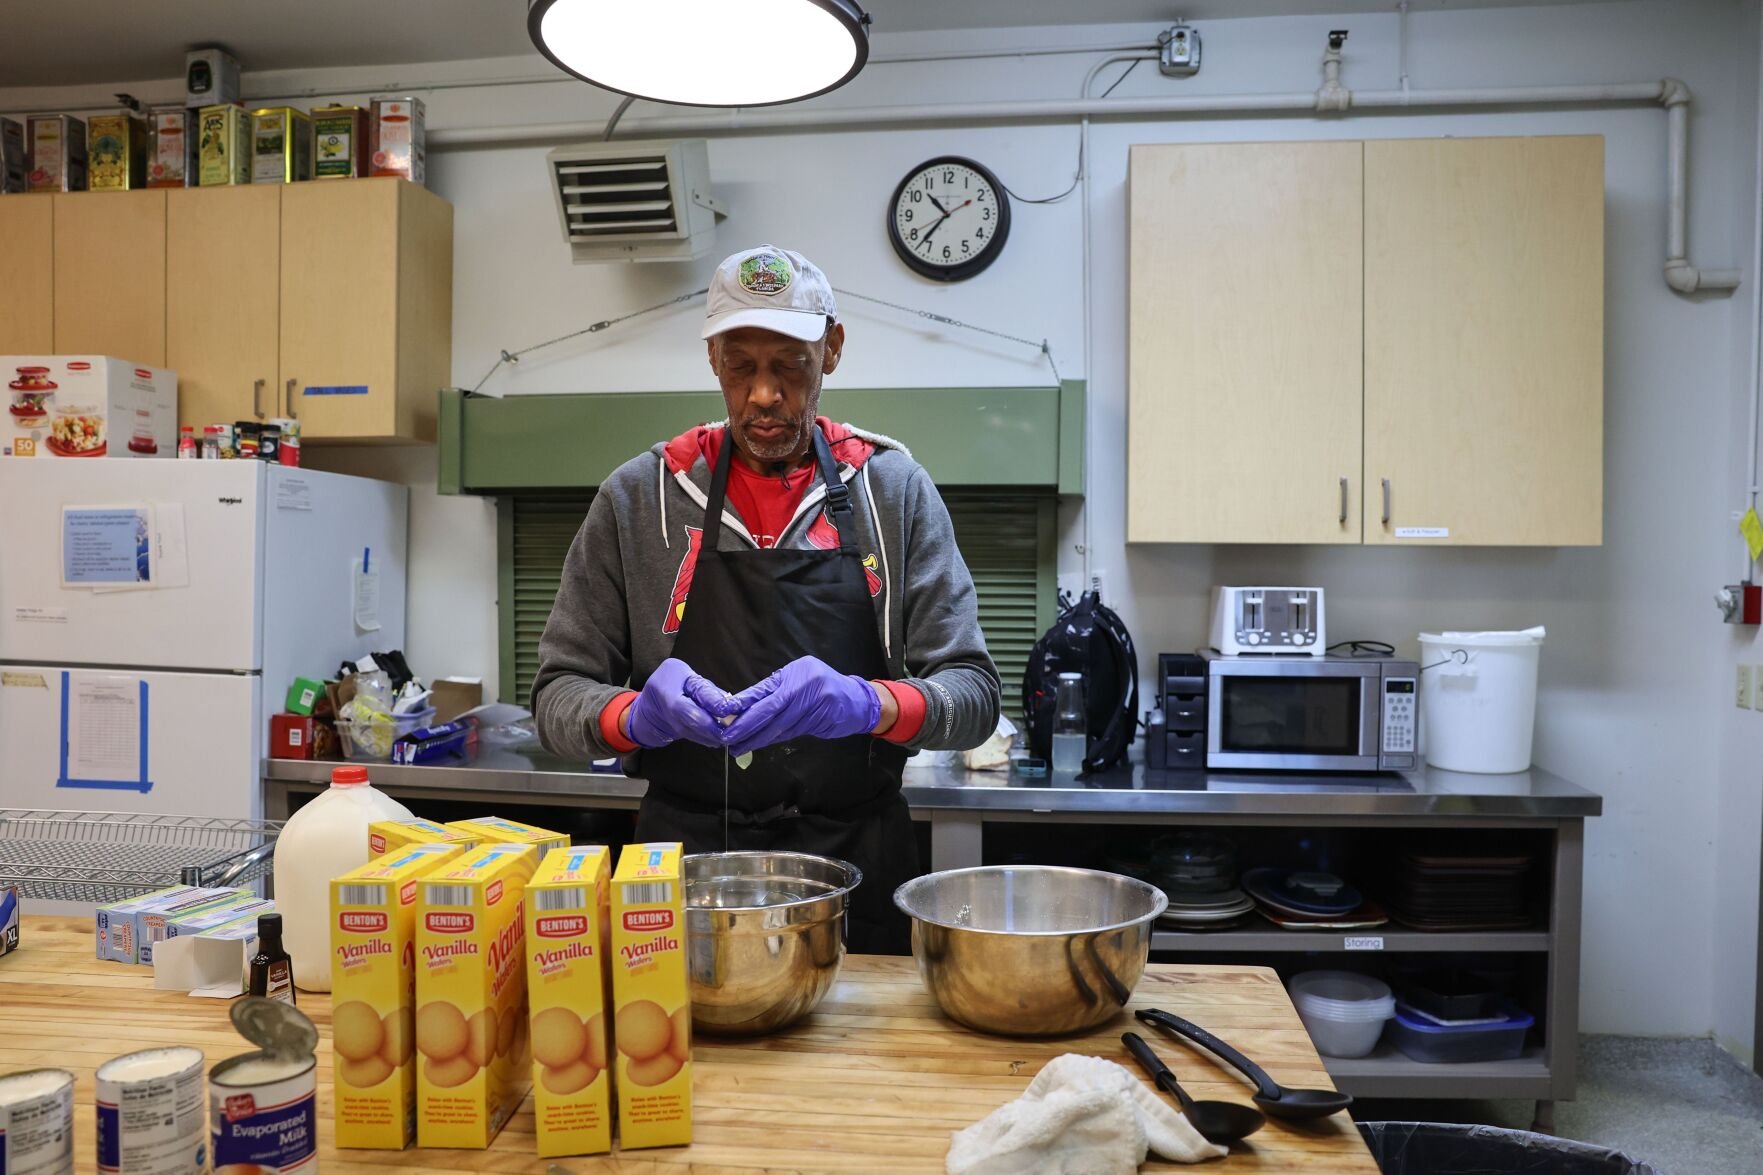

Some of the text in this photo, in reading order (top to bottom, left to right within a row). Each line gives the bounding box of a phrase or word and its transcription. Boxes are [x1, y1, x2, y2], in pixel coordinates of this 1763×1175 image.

[925, 177, 934, 190] 11
[943, 171, 955, 184] 12
[964, 176, 968, 189] 1
[910, 190, 922, 203] 10
[977, 188, 985, 201] 2
[905, 209, 913, 222] 9
[982, 207, 990, 220] 3
[910, 228, 919, 241] 8
[975, 227, 984, 239] 4
[925, 240, 932, 253] 7
[942, 246, 951, 258] 6
[961, 240, 969, 253] 5
[17, 440, 33, 449] 50
[343, 915, 385, 926] BENTON'S
[429, 915, 471, 926] BENTON'S
[540, 918, 584, 931] BENTON'S
[627, 912, 670, 925] BENTON'S
[7, 927, 18, 944] XL
[488, 897, 525, 974] Vanil
[337, 939, 392, 959] Vanilla
[422, 939, 478, 959] Vanilla
[534, 942, 592, 966] Vanilla
[620, 936, 678, 959] Vanilla
[232, 1110, 306, 1138] Evaporated
[279, 1126, 307, 1145] Milk
